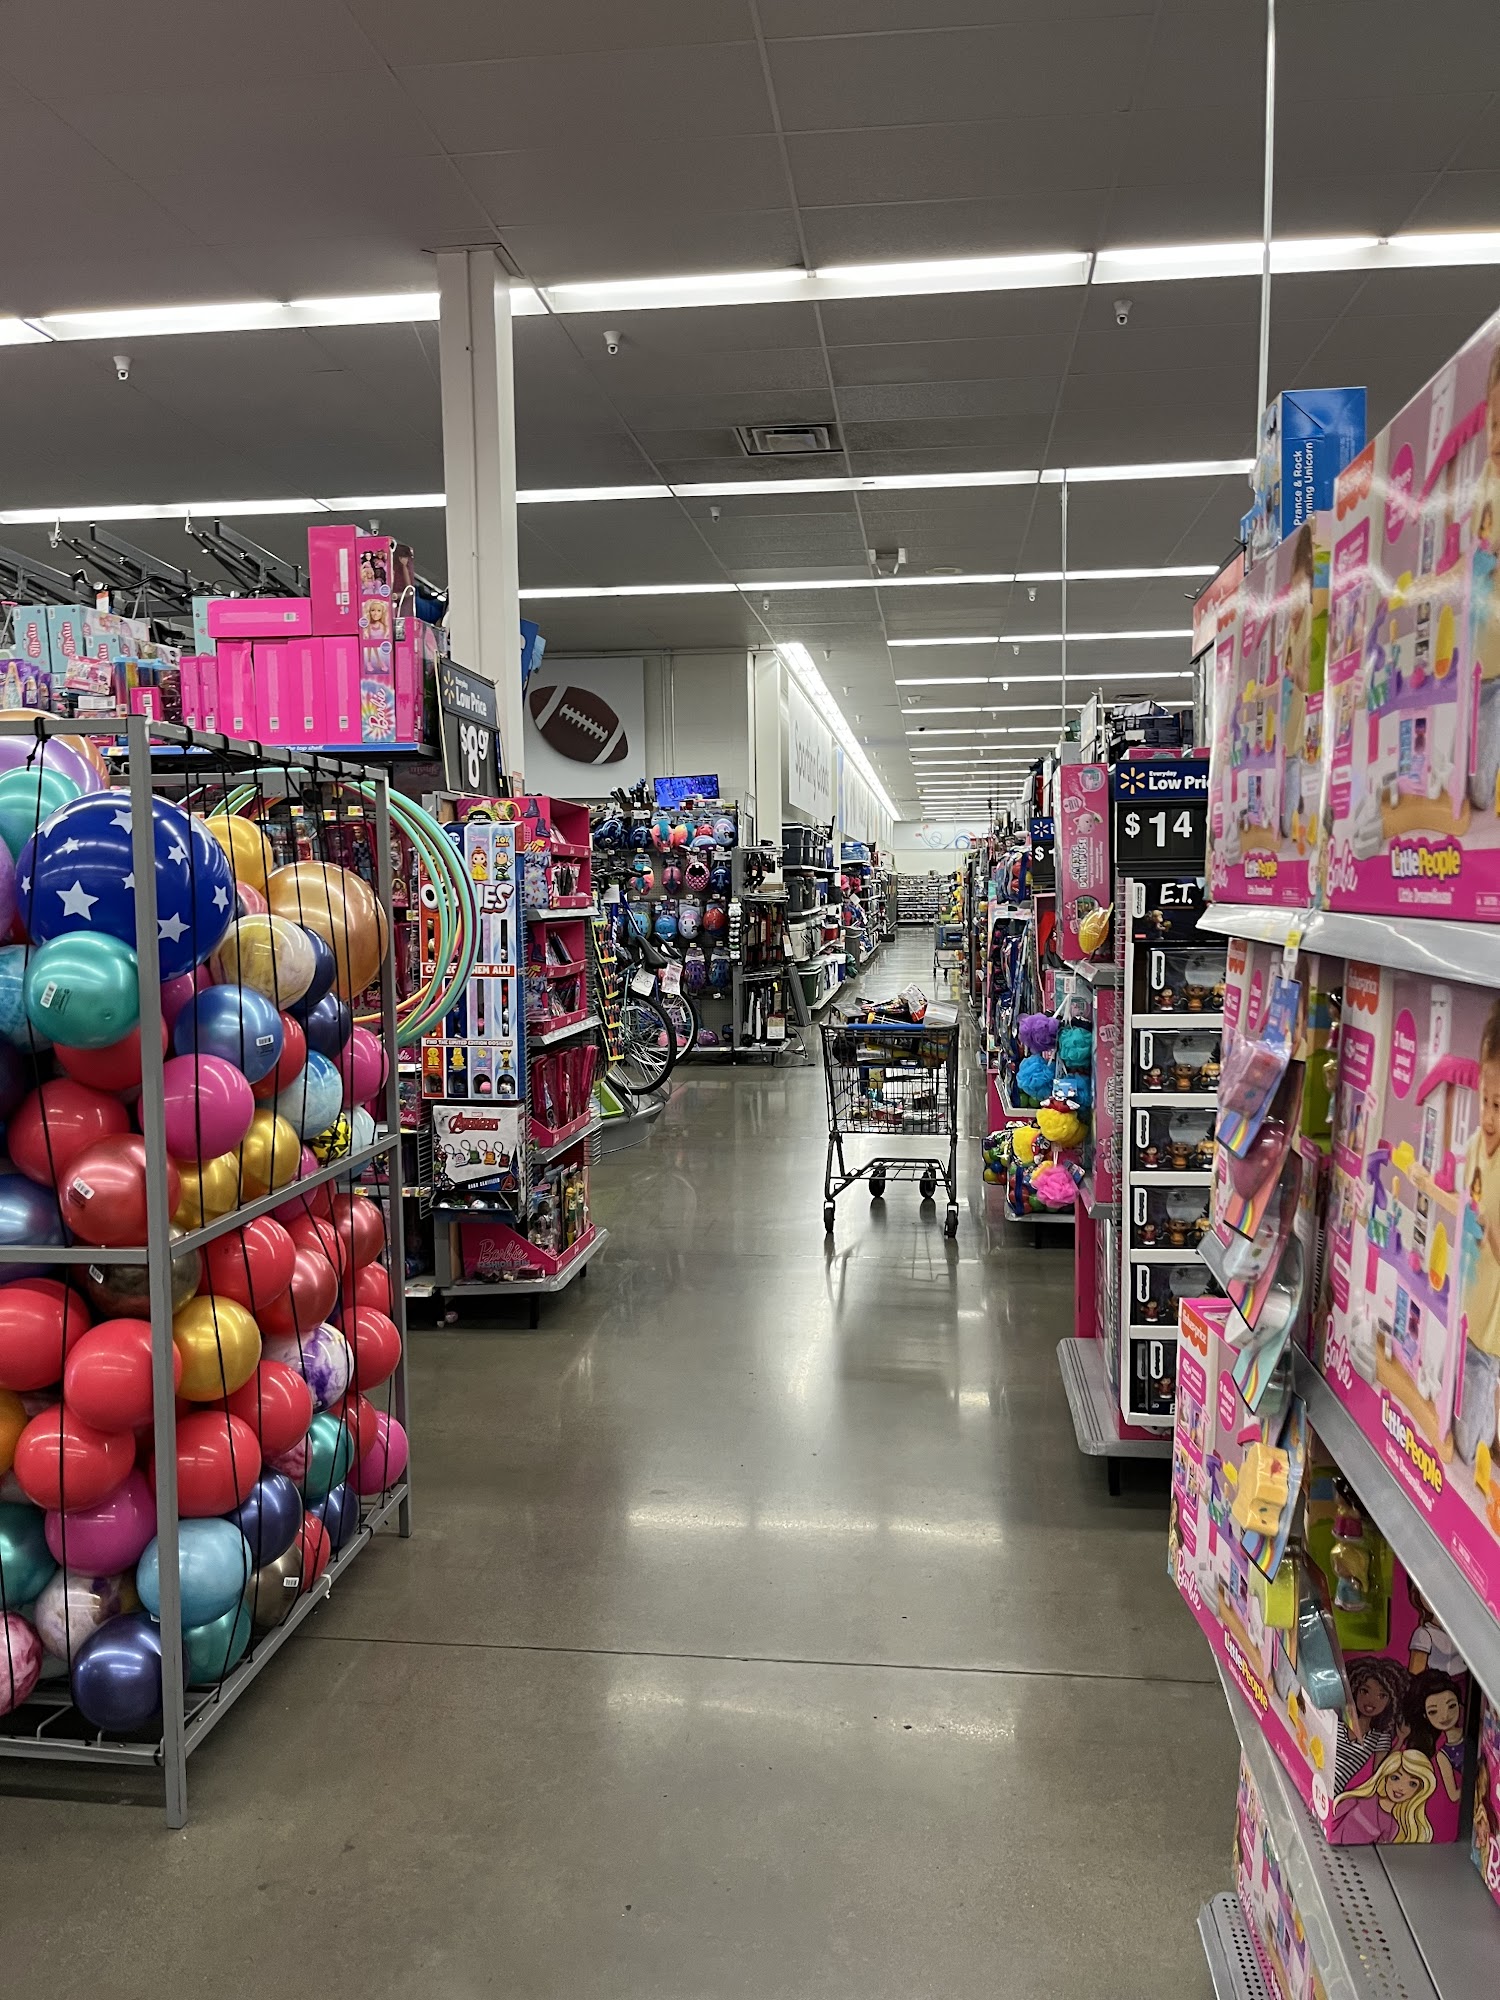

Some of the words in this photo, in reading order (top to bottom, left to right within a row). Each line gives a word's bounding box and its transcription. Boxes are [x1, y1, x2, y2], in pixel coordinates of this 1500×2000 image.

[1293, 450, 1303, 477] Rock
[1304, 442, 1313, 483] Unicorn
[1293, 480, 1303, 488] &
[1304, 486, 1315, 518] arning
[1293, 490, 1303, 526] Prance
[369, 688, 387, 730] Barbie
[456, 685, 471, 709] Low
[471, 692, 487, 716] Price
[297, 744, 309, 752] top
[795, 720, 816, 801] Sporting
[1148, 776, 1182, 790] Low
[1184, 774, 1209, 790] Pri
[495, 835, 511, 843] TOY
[1125, 812, 1141, 838] $
[1148, 811, 1193, 847] 14
[1079, 838, 1087, 888] DOLLHOUSE
[1391, 846, 1419, 877] Little
[1418, 845, 1461, 881] People
[1160, 882, 1196, 905] E.T.
[471, 966, 490, 975] HEM
[492, 966, 511, 975] ALL!
[479, 1238, 528, 1263] Barbie
[1324, 1314, 1353, 1390] Barbie
[1381, 1397, 1406, 1448] Little
[1405, 1430, 1442, 1493] People
[1177, 1549, 1202, 1611] Barbie
[1224, 1630, 1244, 1667] Little
[1241, 1662, 1269, 1712] People
